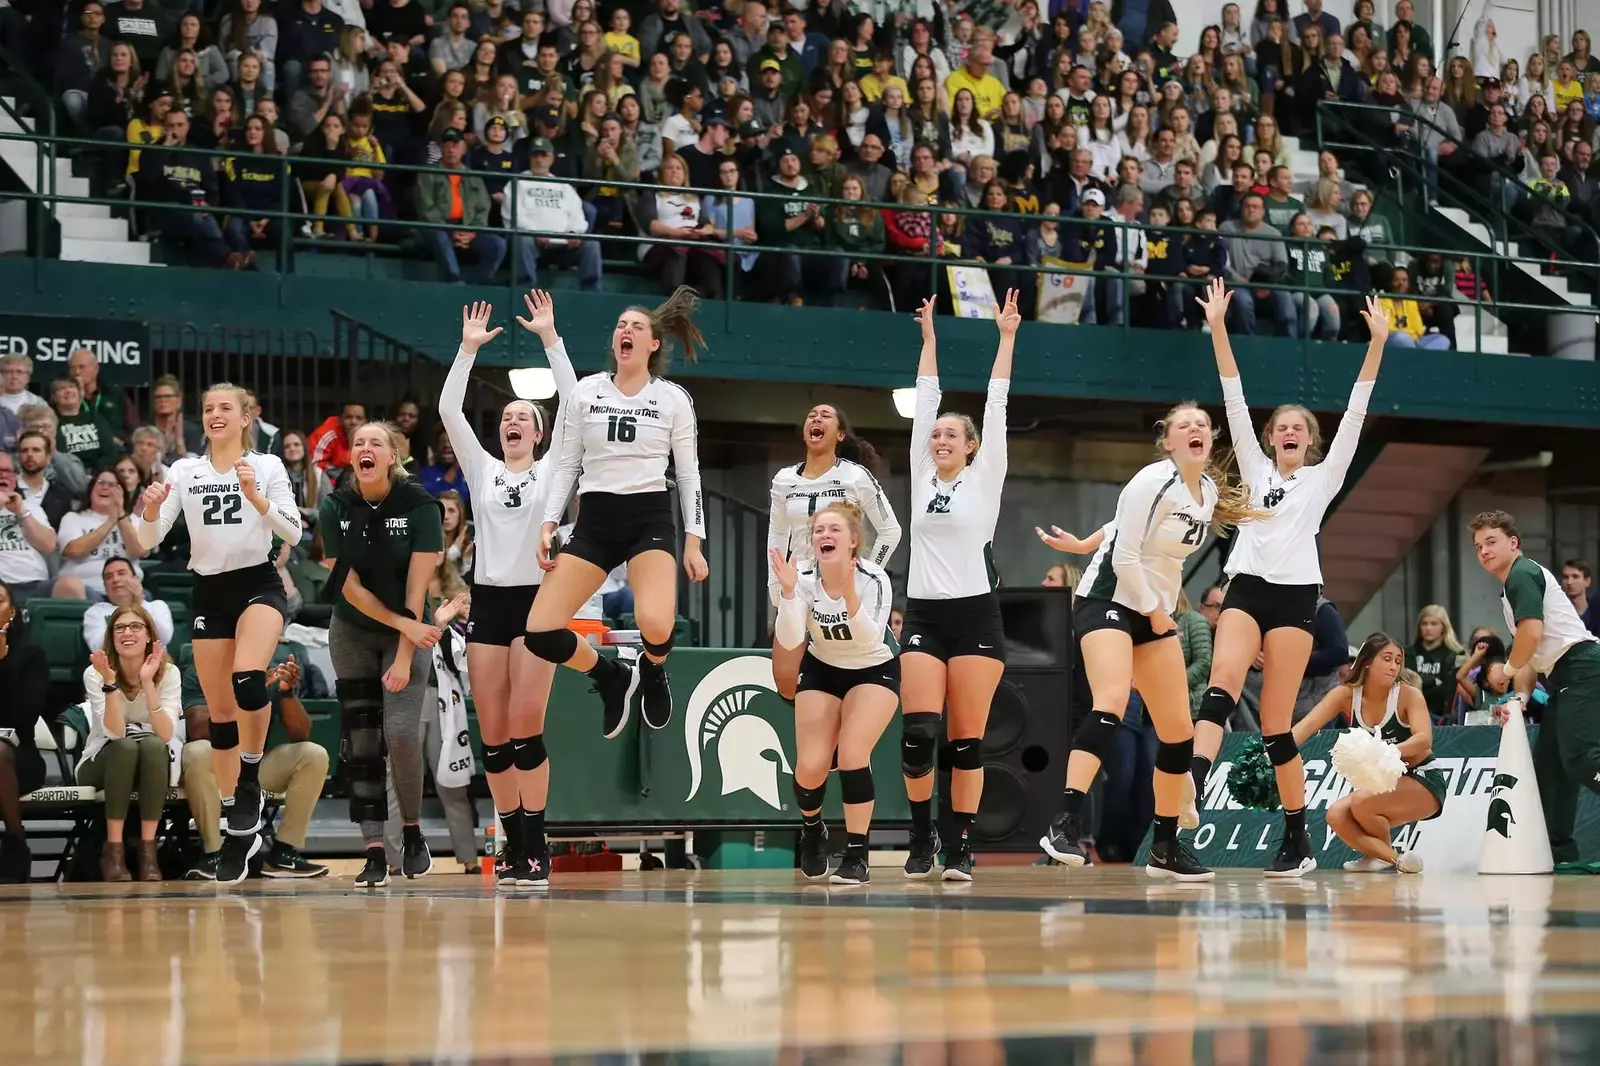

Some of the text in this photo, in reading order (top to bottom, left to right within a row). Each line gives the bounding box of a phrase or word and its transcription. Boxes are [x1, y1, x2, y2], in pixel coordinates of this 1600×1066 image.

[1147, 240, 1168, 259] M
[589, 404, 660, 420] MICHIGAN STATE
[607, 415, 637, 443] 16
[188, 483, 231, 495] MICHIGAN
[821, 489, 847, 498] STATE
[504, 493, 522, 508] 3
[202, 494, 243, 526] 22
[1181, 522, 1205, 546] 21
[820, 623, 853, 640] 10
[31, 790, 79, 801] SPARTANS
